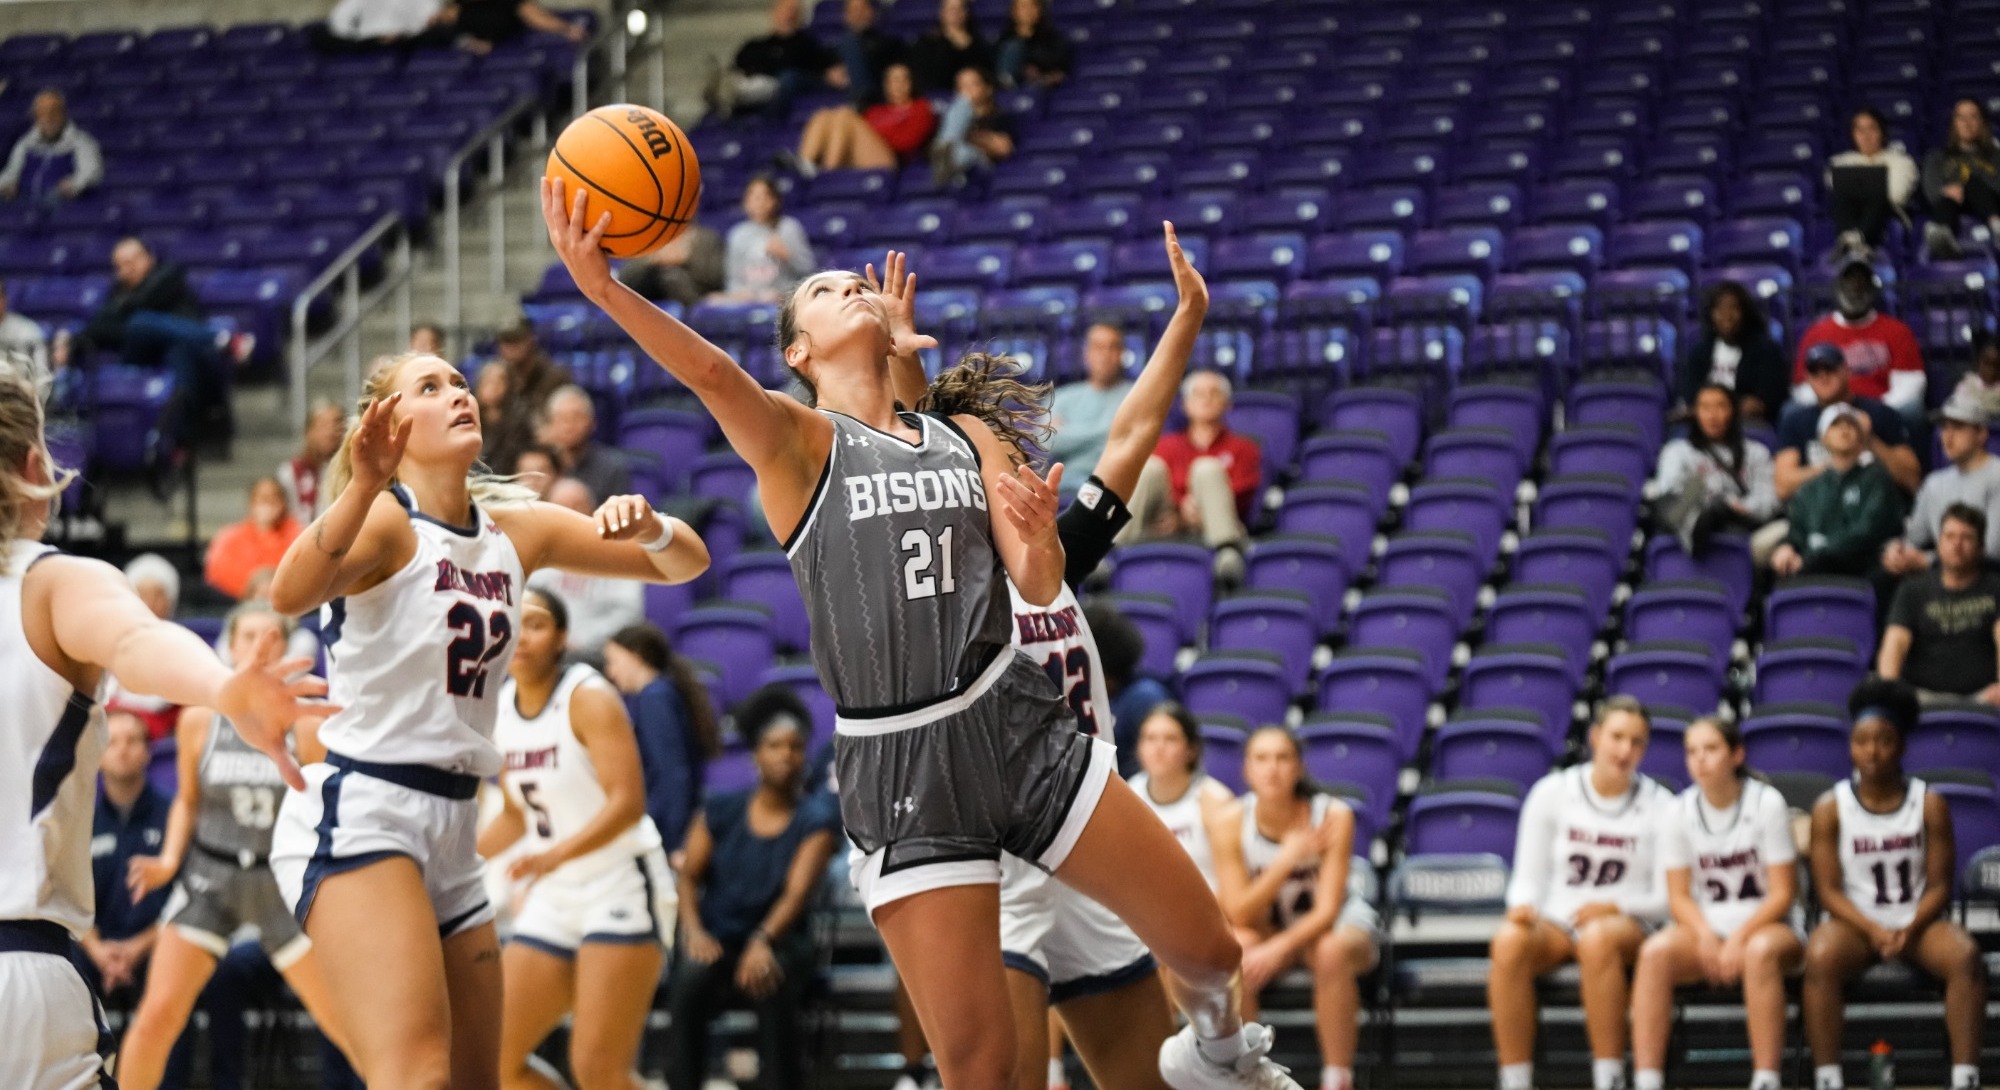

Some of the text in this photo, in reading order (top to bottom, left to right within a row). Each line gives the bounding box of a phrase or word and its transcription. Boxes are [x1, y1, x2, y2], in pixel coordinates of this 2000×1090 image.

[845, 468, 987, 521] BISONS
[901, 525, 956, 600] 21
[447, 600, 512, 698] 22
[519, 783, 552, 838] 5
[1871, 859, 1913, 905] 11
